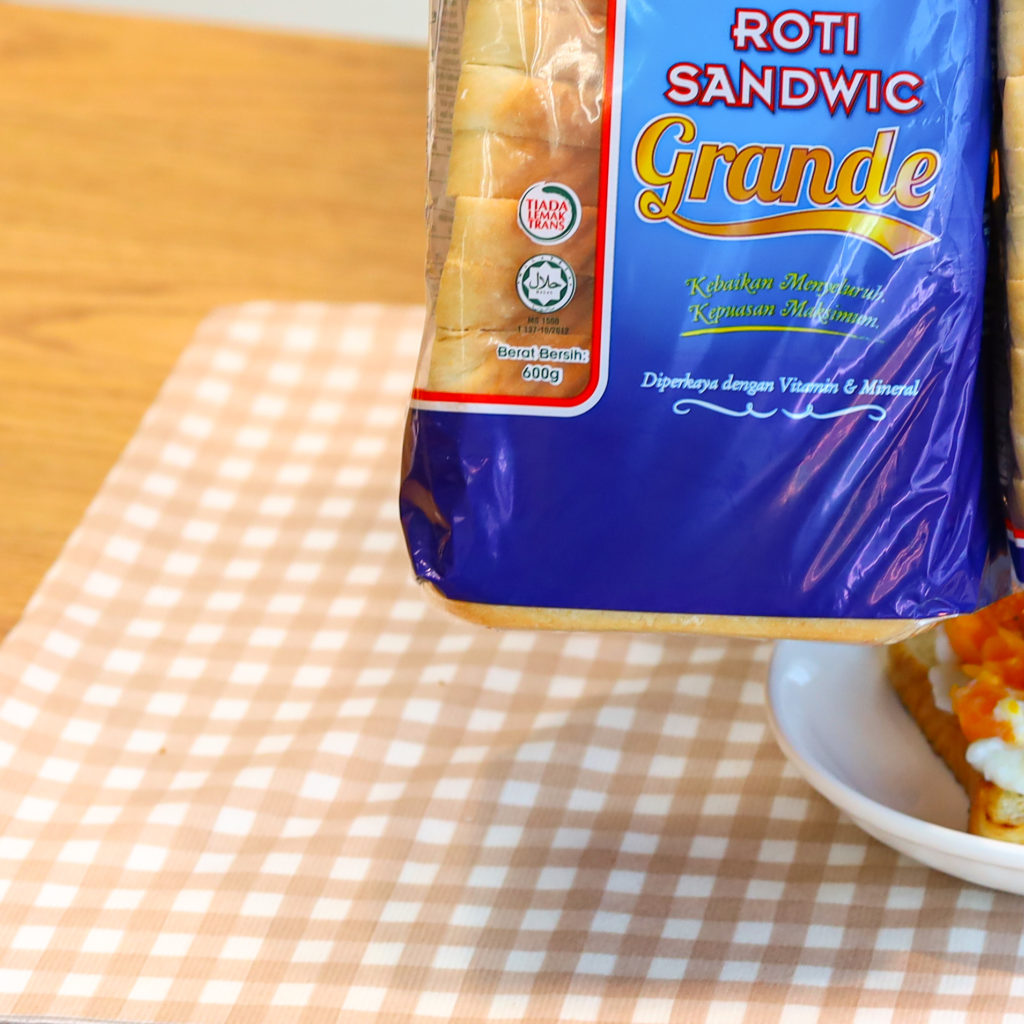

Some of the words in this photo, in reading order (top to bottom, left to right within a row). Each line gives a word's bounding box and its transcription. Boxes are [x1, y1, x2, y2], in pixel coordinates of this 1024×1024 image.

[731, 7, 860, 55] ROTI
[664, 59, 924, 118] SANDWIC
[632, 112, 942, 224] Grande
[526, 198, 568, 212] TIADA
[527, 210, 566, 221] LEMAK
[527, 218, 566, 231] TRANS
[685, 273, 775, 298] Kebaikan
[779, 273, 886, 304] Menyeluruh.
[688, 302, 775, 326] Kepuasan
[780, 299, 881, 329] Maksimum.
[497, 345, 536, 359] Berat
[539, 347, 587, 362] Bersih:
[522, 365, 561, 383] 600g
[641, 371, 718, 394] Diperkaya
[721, 374, 775, 396] dengan
[779, 376, 839, 395] Vitamin
[843, 378, 858, 396] &
[858, 378, 922, 397] Mineral
